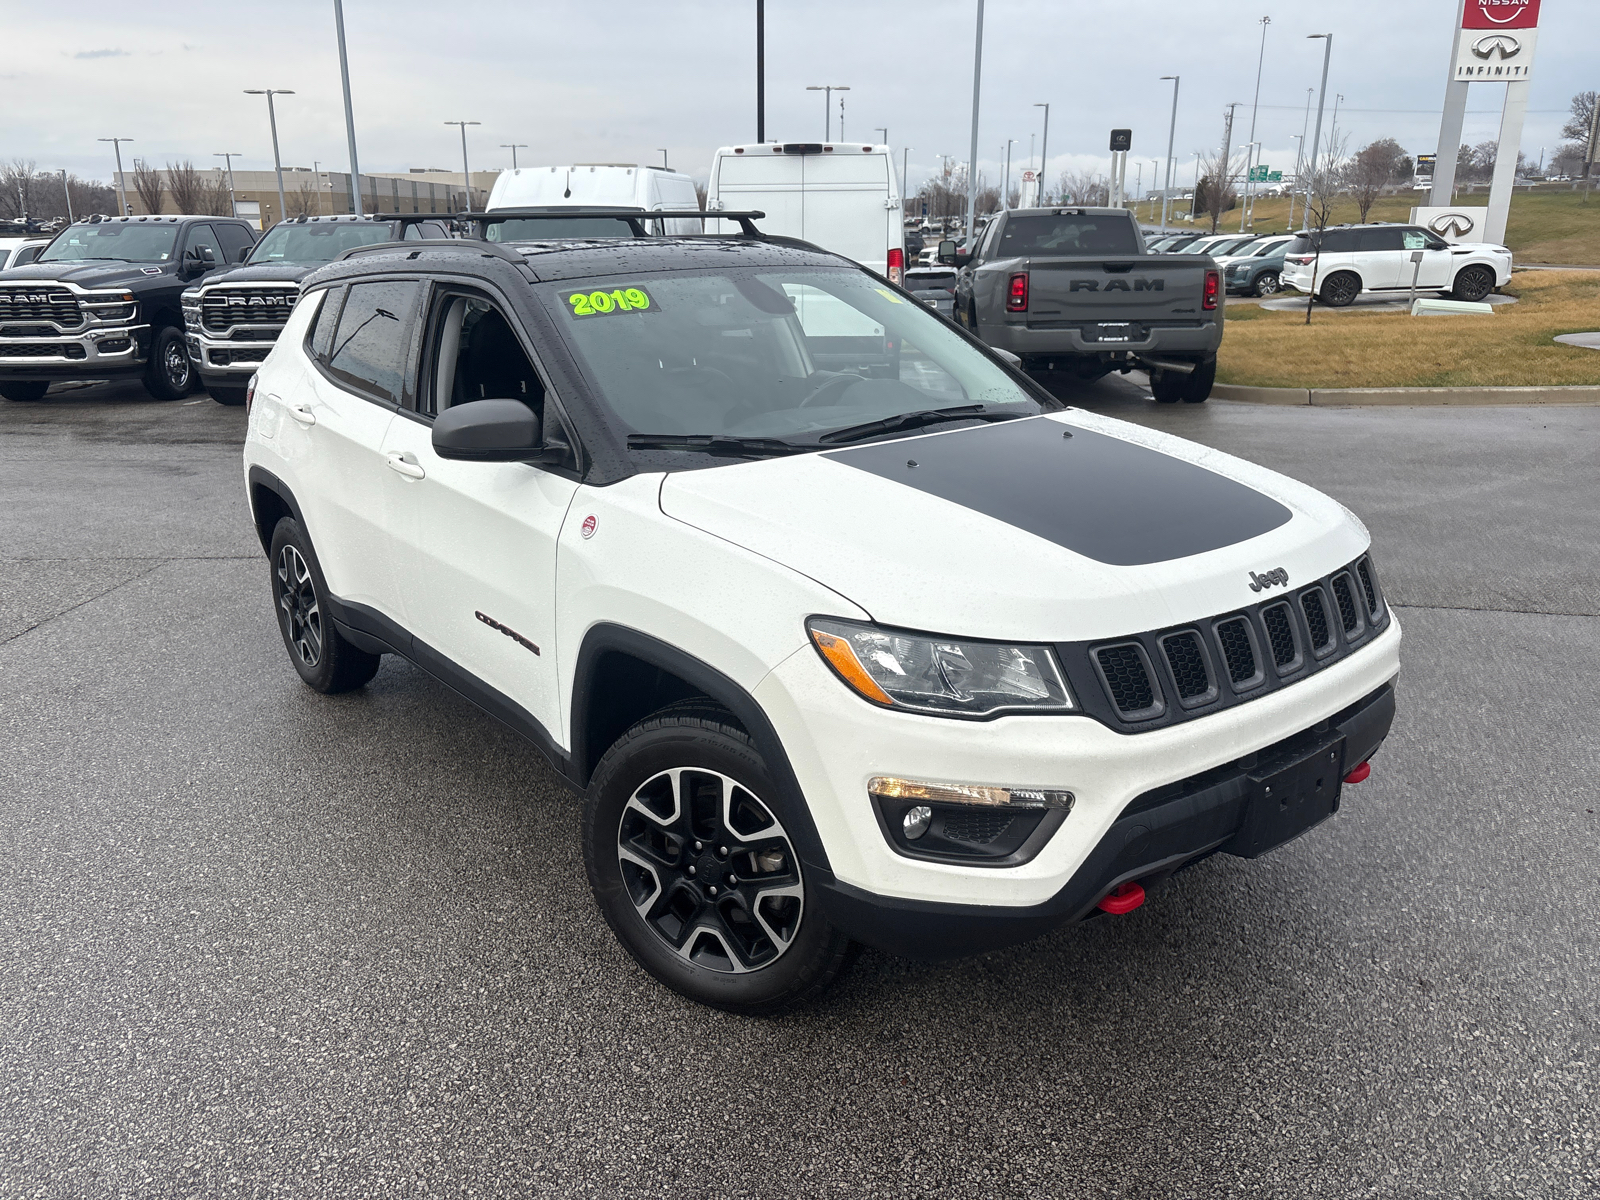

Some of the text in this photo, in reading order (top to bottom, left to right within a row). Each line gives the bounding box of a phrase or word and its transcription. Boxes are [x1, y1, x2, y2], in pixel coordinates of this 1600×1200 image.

[1458, 66, 1529, 76] INFINITI
[1069, 278, 1165, 293] RAM
[228, 296, 285, 306] RAM
[568, 287, 650, 316] 2019
[1248, 566, 1289, 593] Jeep
